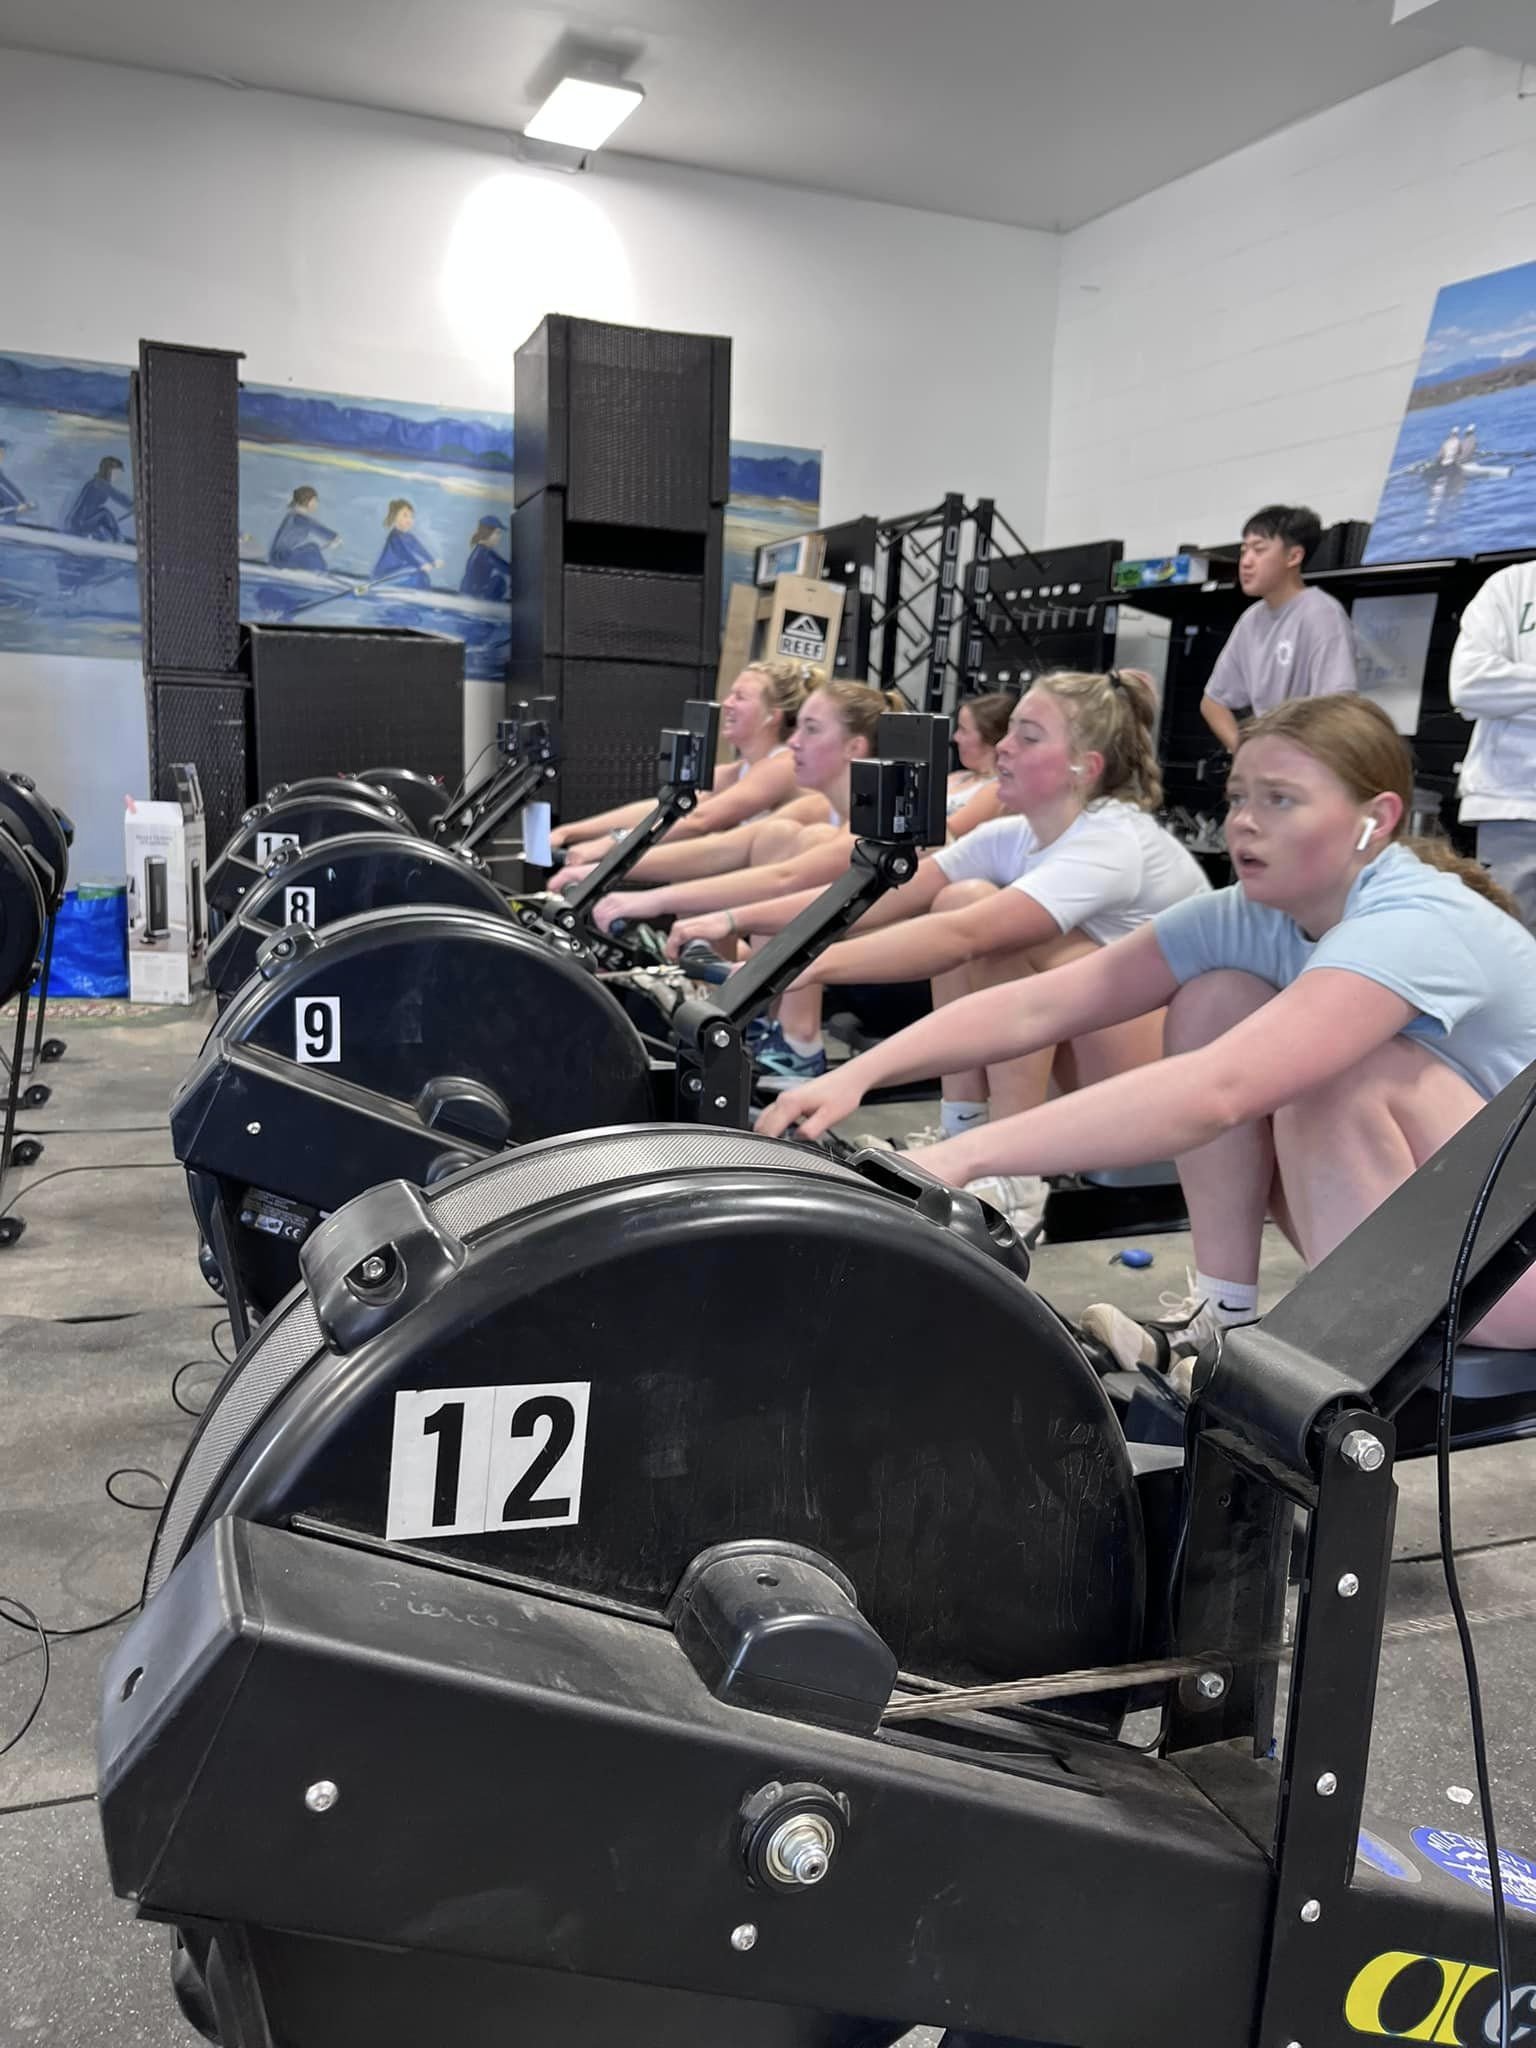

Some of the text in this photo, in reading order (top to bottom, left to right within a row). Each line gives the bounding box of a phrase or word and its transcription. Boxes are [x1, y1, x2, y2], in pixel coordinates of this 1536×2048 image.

[783, 637, 823, 659] REEF
[290, 891, 309, 925] 8
[304, 1002, 333, 1058] 9
[423, 1395, 576, 1528] 12
